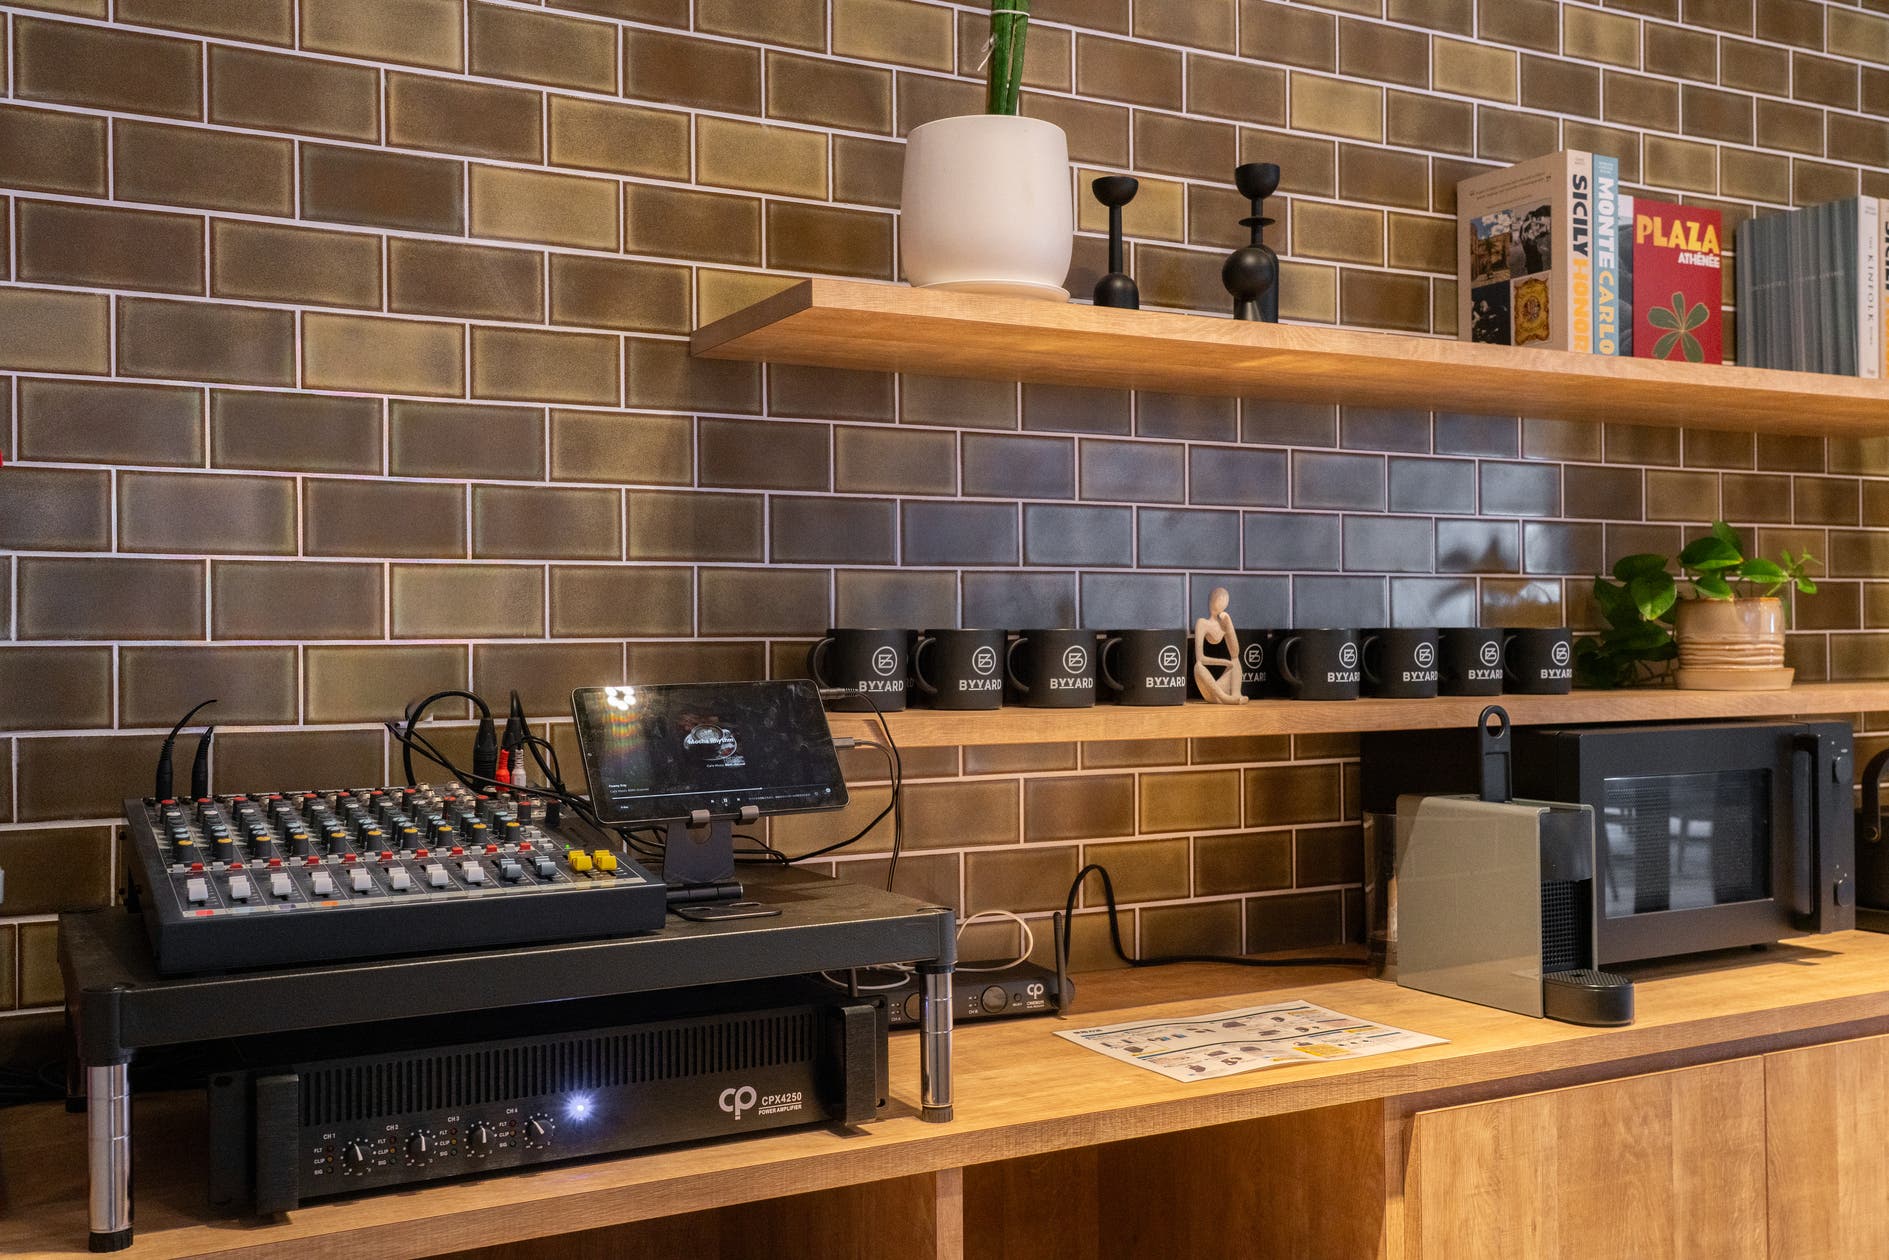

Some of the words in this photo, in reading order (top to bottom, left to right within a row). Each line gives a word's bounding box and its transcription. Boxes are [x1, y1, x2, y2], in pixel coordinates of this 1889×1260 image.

[1572, 174, 1588, 257] SICILY
[1598, 176, 1615, 269] MONTE
[1636, 214, 1720, 254] PLAZA
[1678, 252, 1720, 268] ATHÉNÉE
[1573, 258, 1589, 351] HONOR
[1598, 270, 1615, 355] CARLO
[1402, 671, 1438, 682] BYYARD
[1468, 669, 1503, 680] BYYARD
[859, 680, 904, 692] BYYARD
[959, 679, 1002, 691] BYYARD
[1050, 678, 1094, 689] BYYARD
[1146, 677, 1186, 688] BYYARD
[761, 1091, 802, 1106] CPX4250
[758, 1107, 777, 1116] POWER
[777, 1104, 802, 1113] AMPLIFIER
